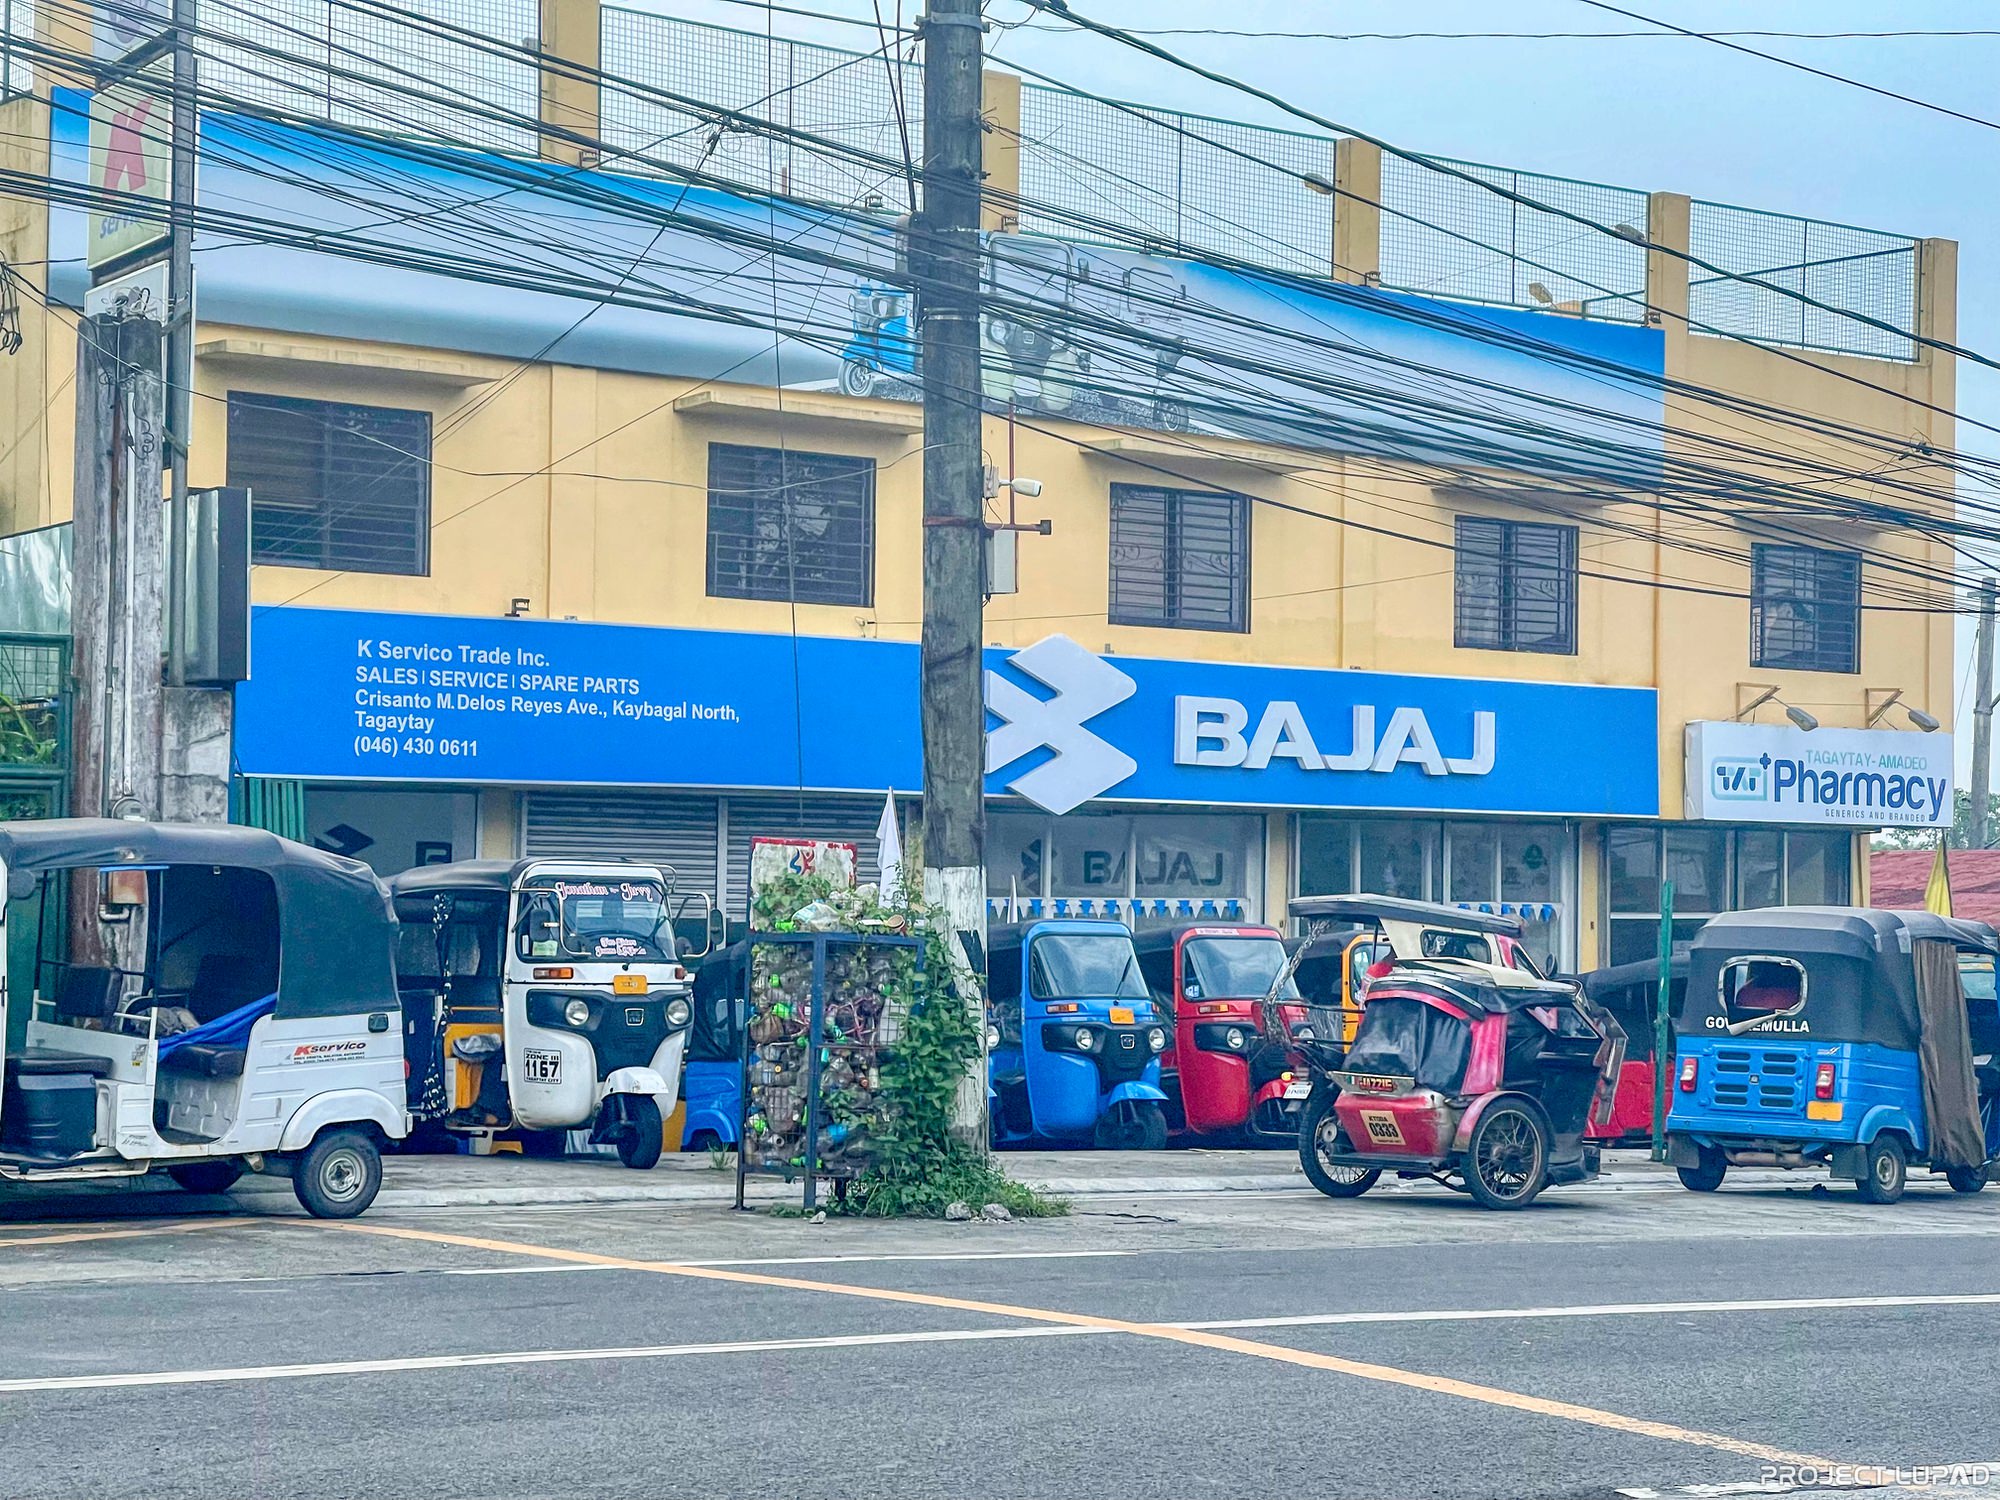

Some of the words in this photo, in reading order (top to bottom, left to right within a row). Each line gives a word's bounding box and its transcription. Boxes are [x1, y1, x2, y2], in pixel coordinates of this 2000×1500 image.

[357, 639, 373, 658] K
[378, 641, 453, 662] Servico
[458, 645, 511, 665] Trade
[517, 648, 550, 667] Inc.
[355, 666, 418, 685] SALES
[429, 670, 508, 688] SERVICE
[520, 674, 578, 692] SPARE
[583, 677, 640, 695] PARTS
[355, 688, 431, 709] Crisanto
[511, 696, 562, 717] Reyes
[566, 698, 607, 718] Ave.,
[612, 699, 687, 722] Kaybagal
[691, 704, 740, 723] North,
[354, 710, 434, 734] Tagaytay
[1174, 695, 1496, 776] BAJAJ
[354, 735, 398, 758] (046)
[403, 737, 434, 754] 430
[440, 739, 477, 756] 0611
[1879, 754, 1927, 770] AMADEO
[1774, 759, 1946, 821] Pharmacy
[1825, 808, 1865, 818] GENERICS
[1869, 811, 1885, 820] AND
[1889, 812, 1925, 822] BRANDED
[1084, 851, 1223, 886] BAJAJ
[555, 882, 609, 900] Jonathan
[1749, 1019, 1810, 1033] EMULLA
[526, 1053, 549, 1061] ZONE
[526, 1060, 559, 1078] 1167
[1360, 1077, 1393, 1088] JAZZIE
[1369, 1122, 1399, 1138] 0333
